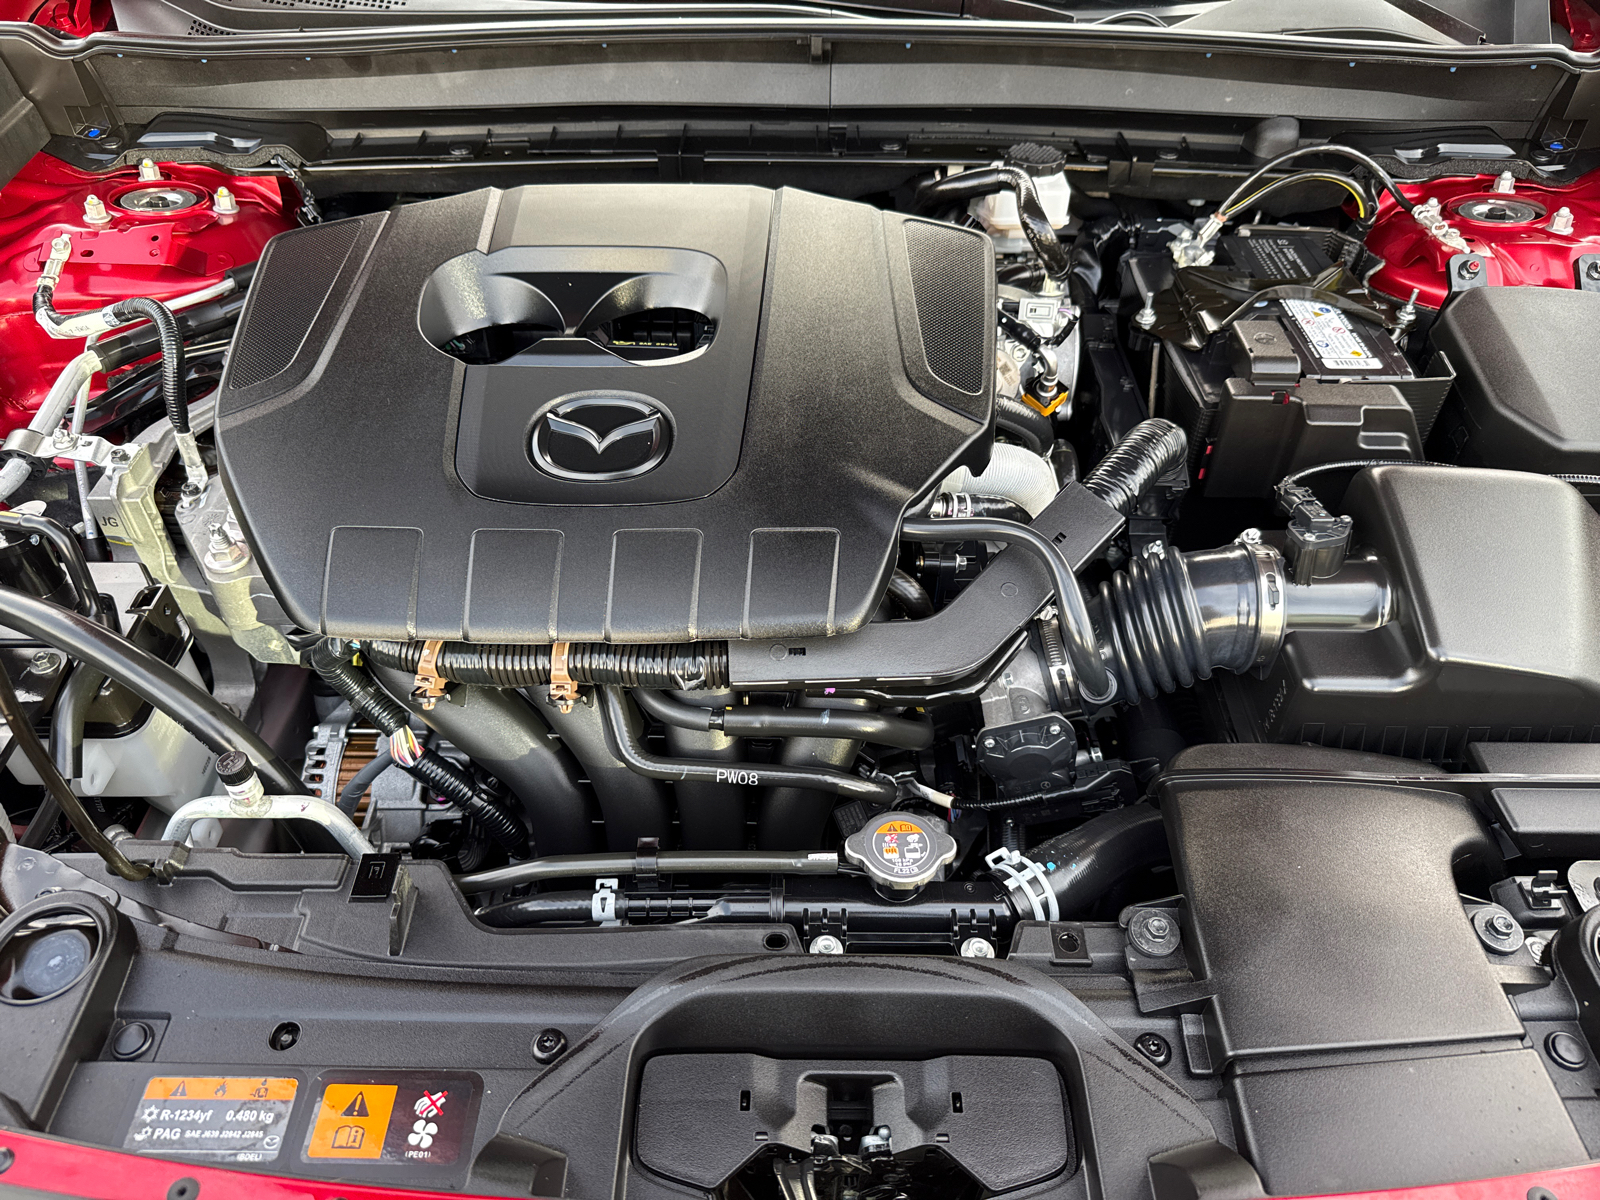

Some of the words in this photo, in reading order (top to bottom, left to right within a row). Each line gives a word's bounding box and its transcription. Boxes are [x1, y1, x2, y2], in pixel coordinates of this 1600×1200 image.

[102, 516, 118, 527] JG
[716, 769, 758, 785] PW08
[160, 1109, 213, 1123] R-1234yf
[225, 1110, 257, 1121] 0.480
[259, 1110, 274, 1123] kg
[153, 1128, 181, 1139] PAG
[184, 1130, 202, 1138] SAE
[201, 1130, 219, 1138] J639
